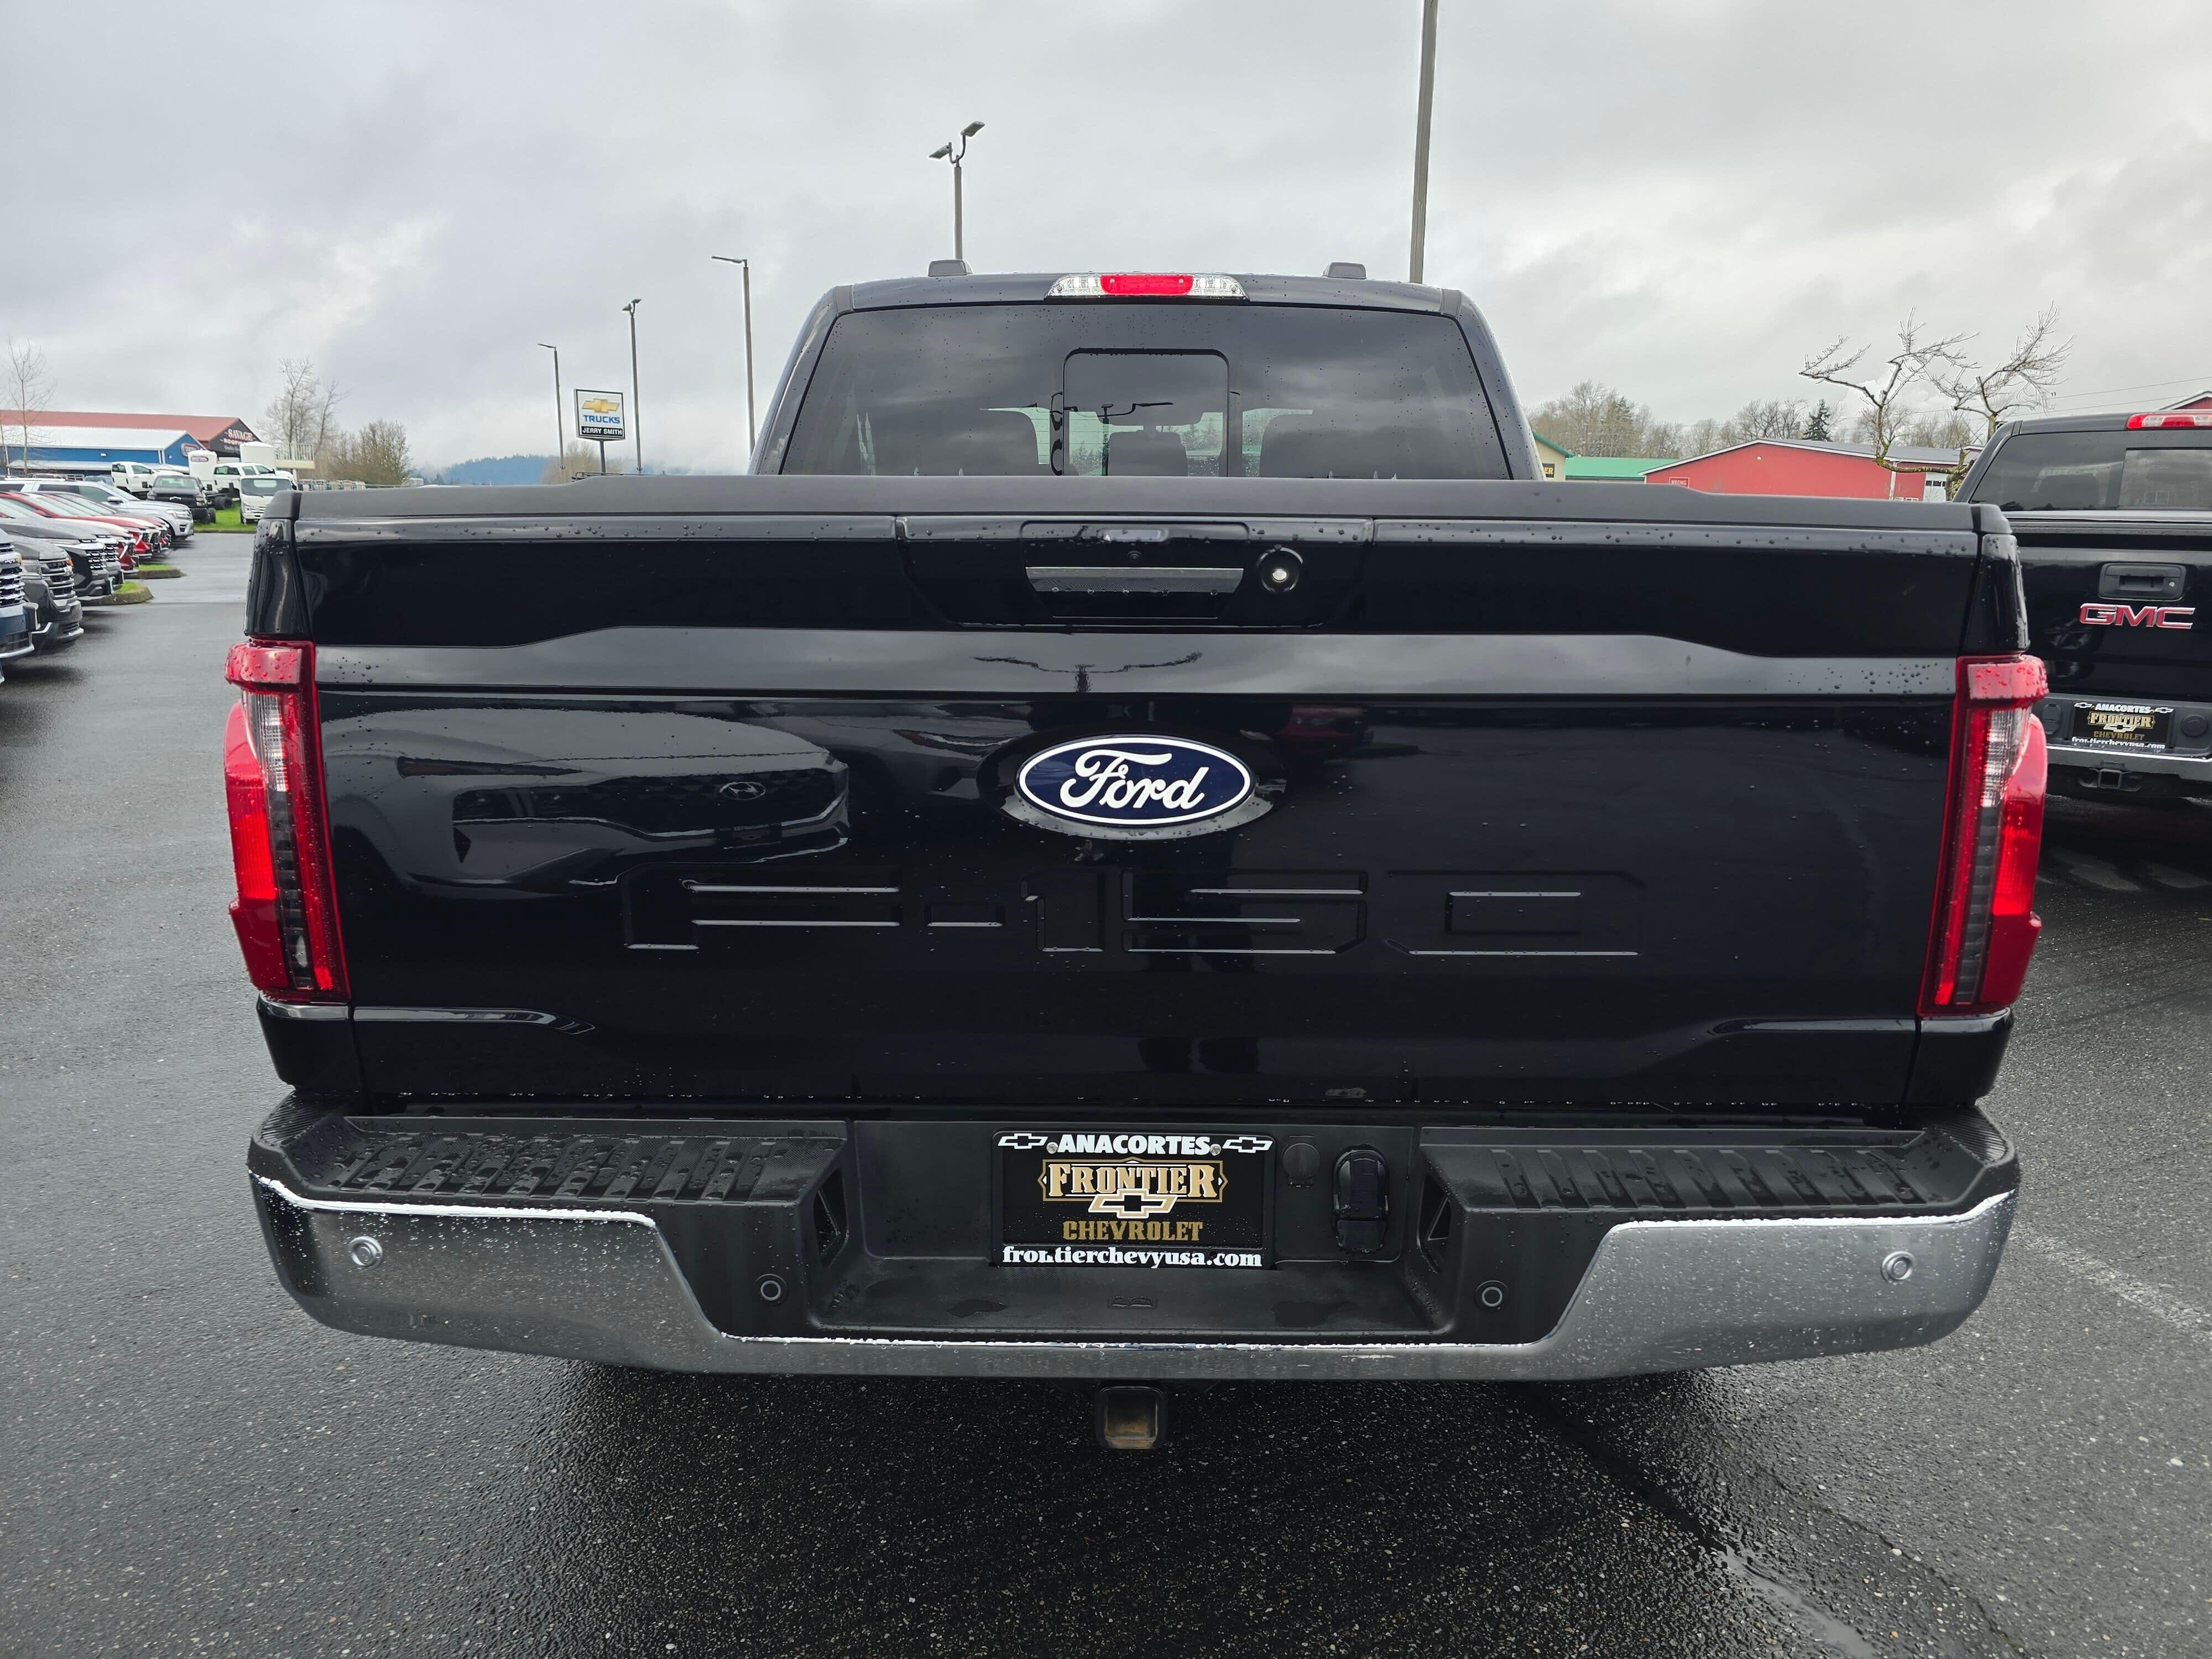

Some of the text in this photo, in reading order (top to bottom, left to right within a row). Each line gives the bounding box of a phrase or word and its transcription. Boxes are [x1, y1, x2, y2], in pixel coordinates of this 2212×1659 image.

[583, 415, 620, 424] TRUCKS
[227, 429, 253, 441] SAVAGE
[2079, 603, 2195, 629] GMC
[2095, 703, 2151, 714] ANACORTES
[2090, 713, 2151, 728] FRONTIER
[2094, 731, 2145, 740] CHEVROLET
[1060, 749, 1209, 810] Ford
[623, 863, 1648, 956] F-150
[1057, 1134, 1211, 1155] ANACORTES
[1048, 1164, 1218, 1198] FRONTIER
[1062, 1220, 1203, 1241] CHEVROLET
[1002, 1246, 1262, 1269] frontierchevyusa.com
